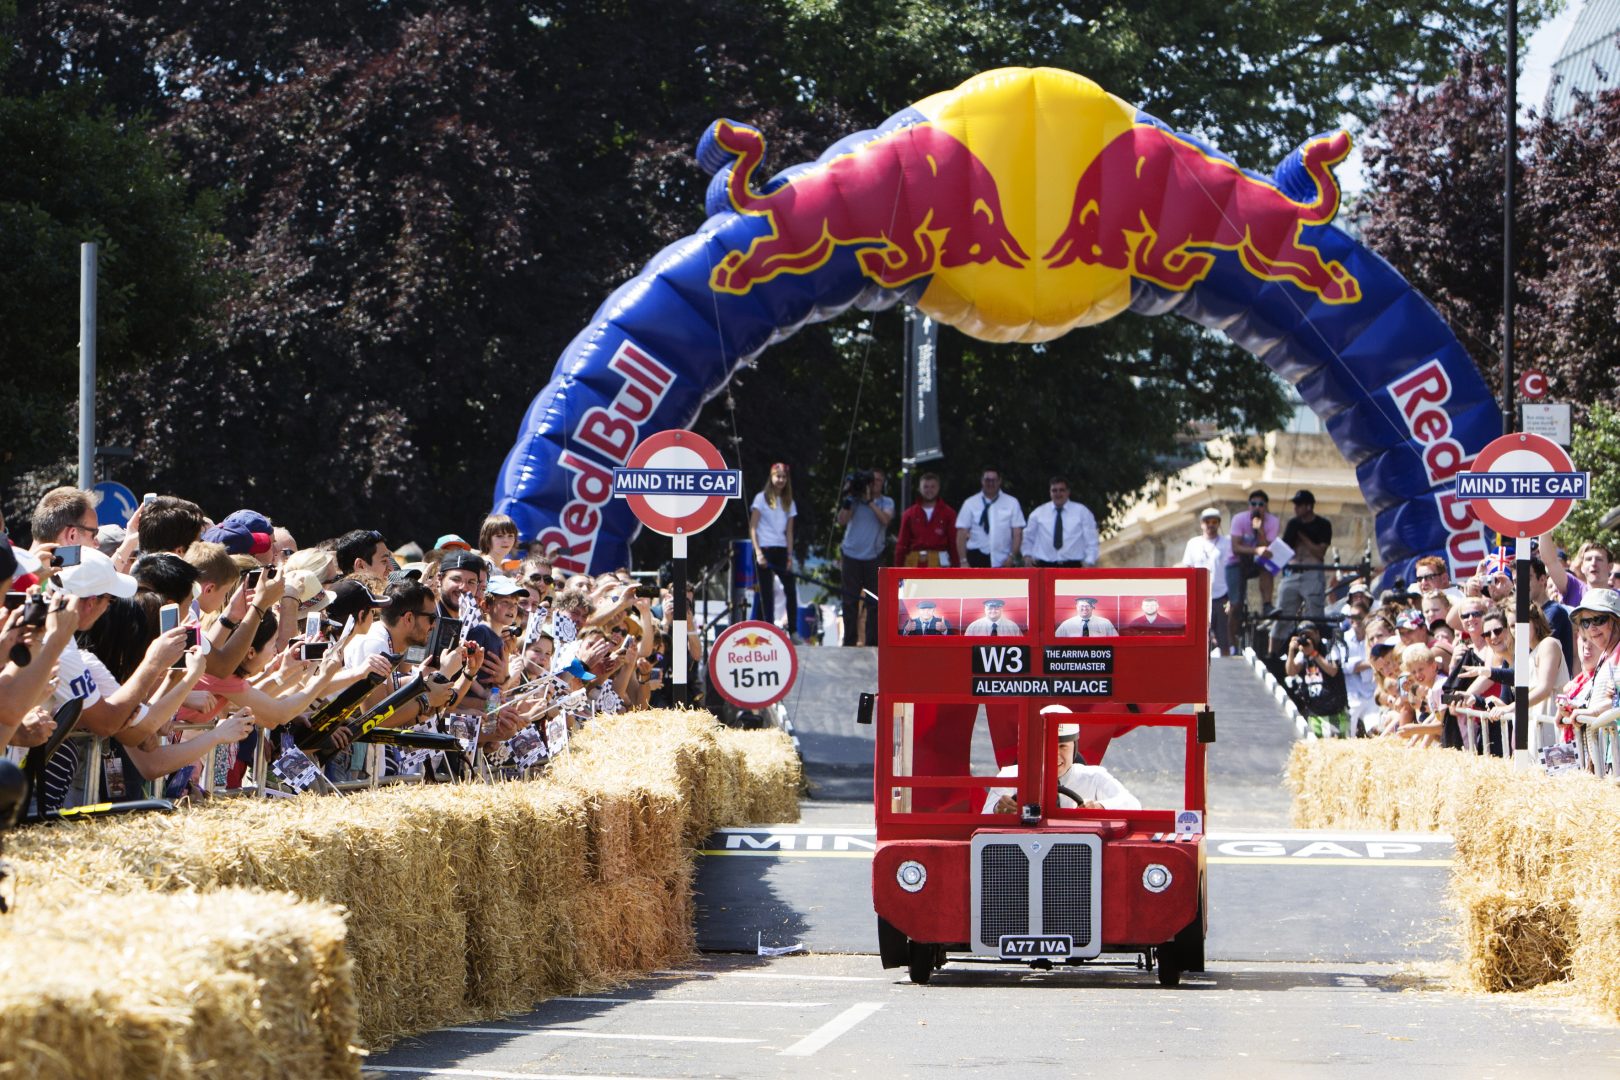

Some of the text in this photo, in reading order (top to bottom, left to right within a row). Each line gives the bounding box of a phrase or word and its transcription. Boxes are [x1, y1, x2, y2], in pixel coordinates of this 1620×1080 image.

[1525, 374, 1543, 395] C
[1387, 358, 1479, 486] Red
[537, 339, 677, 575] Red Bull
[617, 473, 736, 491] MIND THE GAP
[1460, 477, 1583, 494] MIND THE GAP
[728, 649, 778, 663] Red Bull
[980, 646, 1023, 673] W3
[1046, 650, 1111, 658] THE ARRIVA BOYS
[1050, 662, 1106, 671] ROUTEMASTER
[976, 680, 1108, 693] ALEXANDRA PALACE
[725, 835, 1422, 858] MIN GAP
[1005, 941, 1067, 953] A77 IVA
